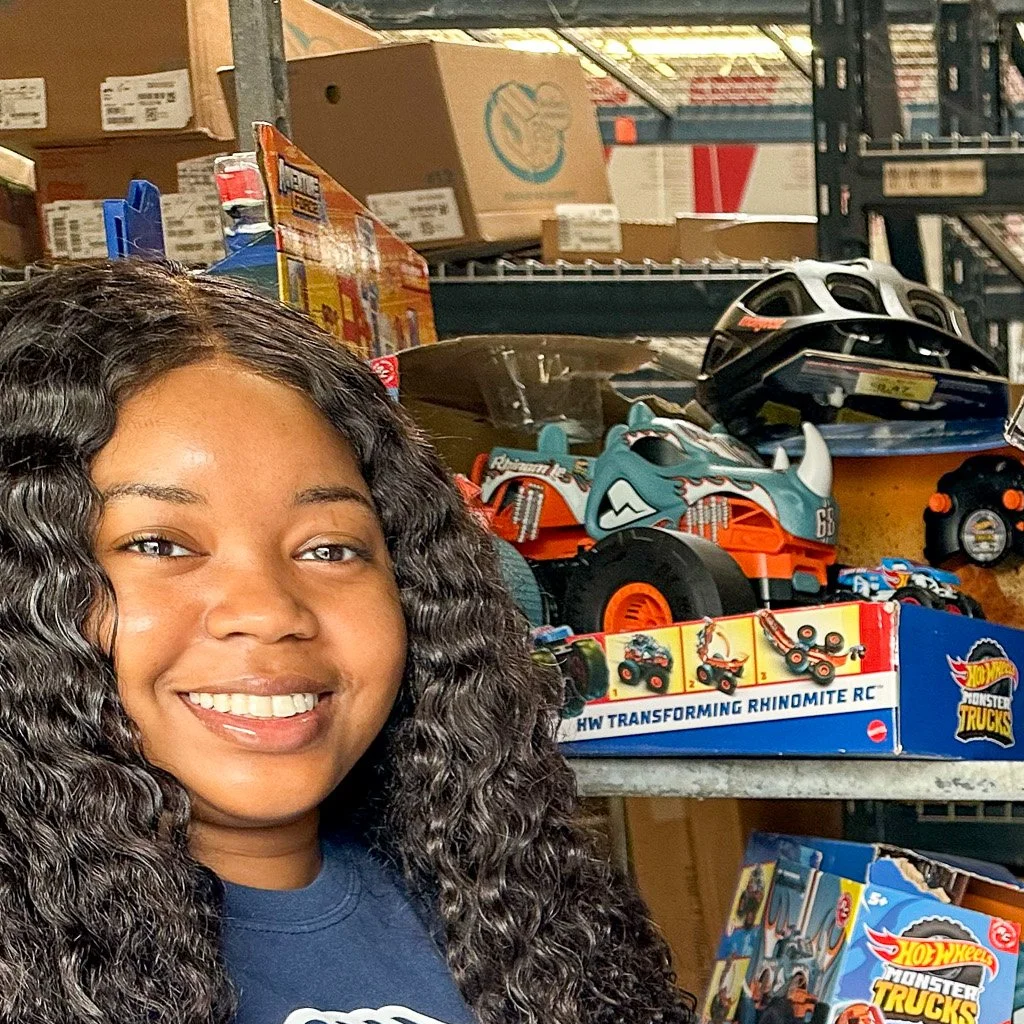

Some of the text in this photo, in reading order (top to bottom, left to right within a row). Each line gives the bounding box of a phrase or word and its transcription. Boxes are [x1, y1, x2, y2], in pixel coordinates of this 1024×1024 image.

[576, 685, 877, 732] HW TRANSFORMING RHINOMITE RC
[962, 691, 1012, 708] MONSTER
[959, 703, 1013, 738] TRUCKS
[867, 891, 888, 906] 5+
[884, 964, 980, 1000] MONSTER
